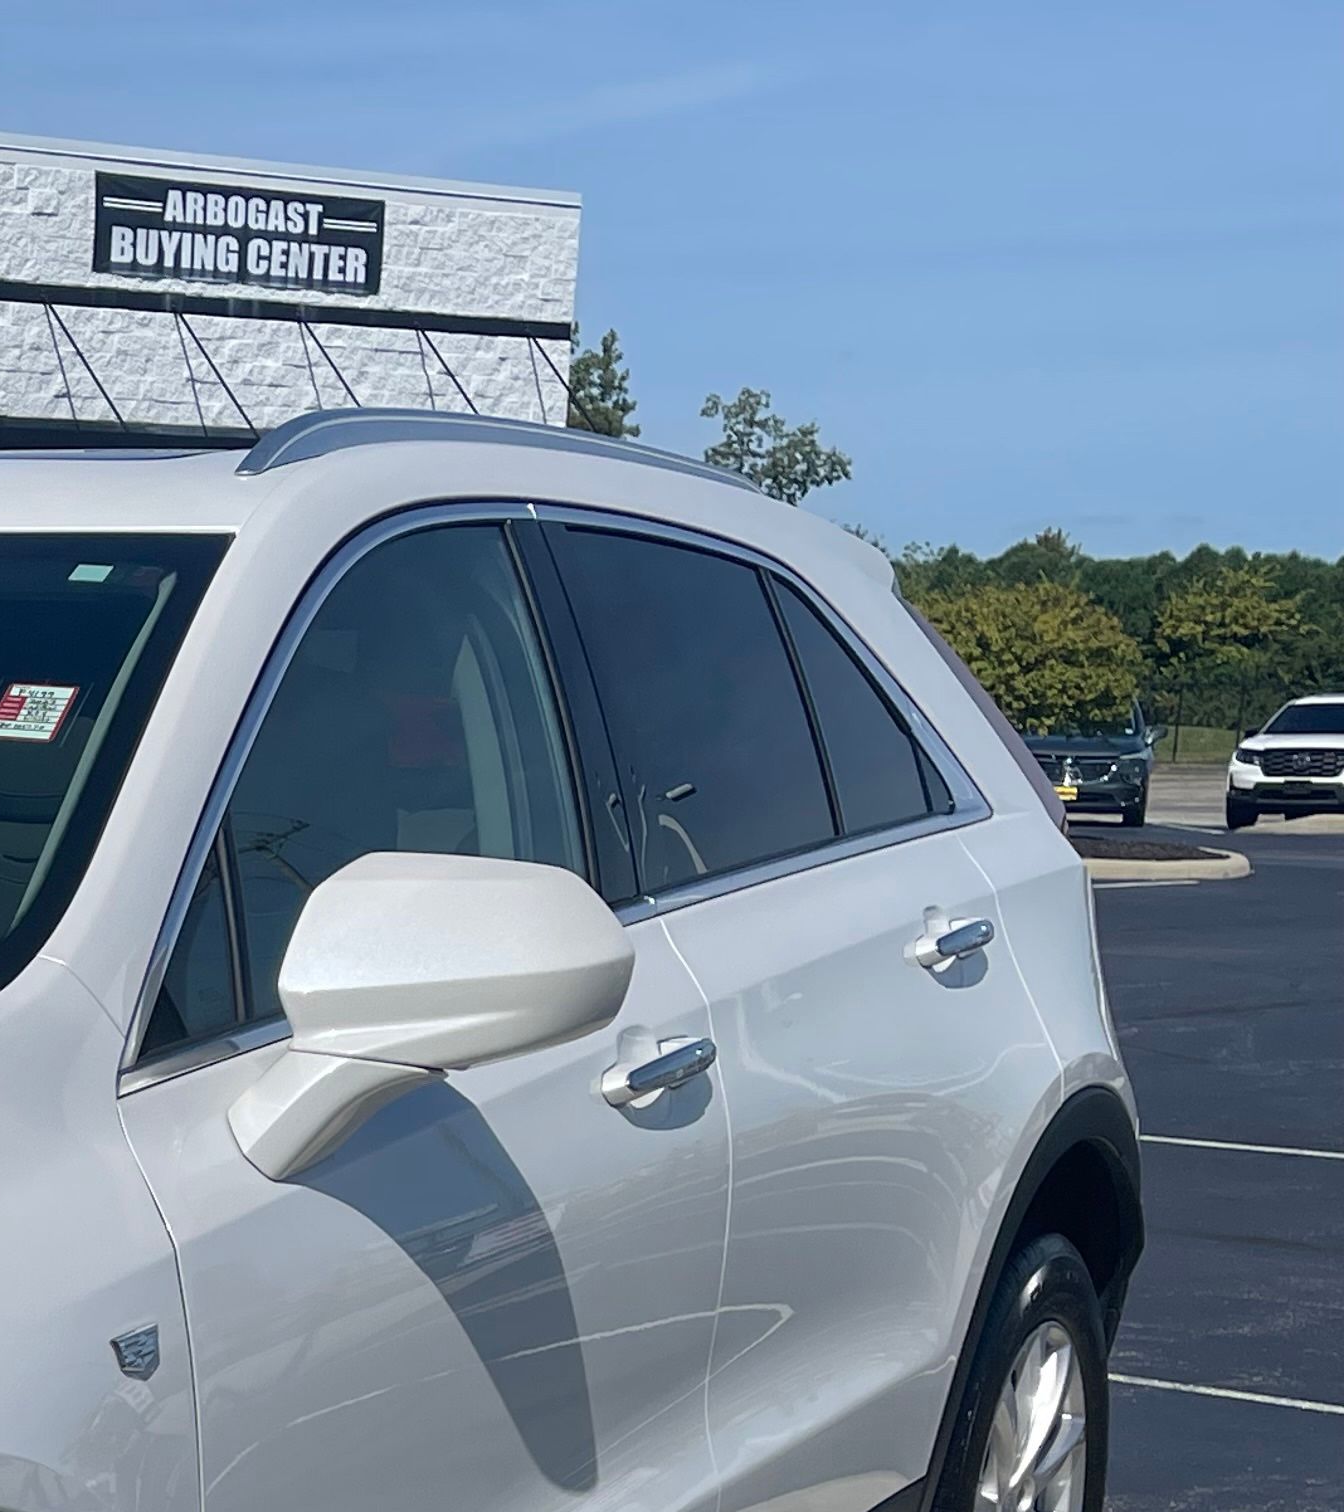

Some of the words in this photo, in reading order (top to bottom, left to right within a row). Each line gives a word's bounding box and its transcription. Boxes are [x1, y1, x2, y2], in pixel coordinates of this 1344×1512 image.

[163, 189, 324, 235] ARBOGAST
[110, 225, 240, 273] BUYING
[246, 237, 368, 284] CENTER
